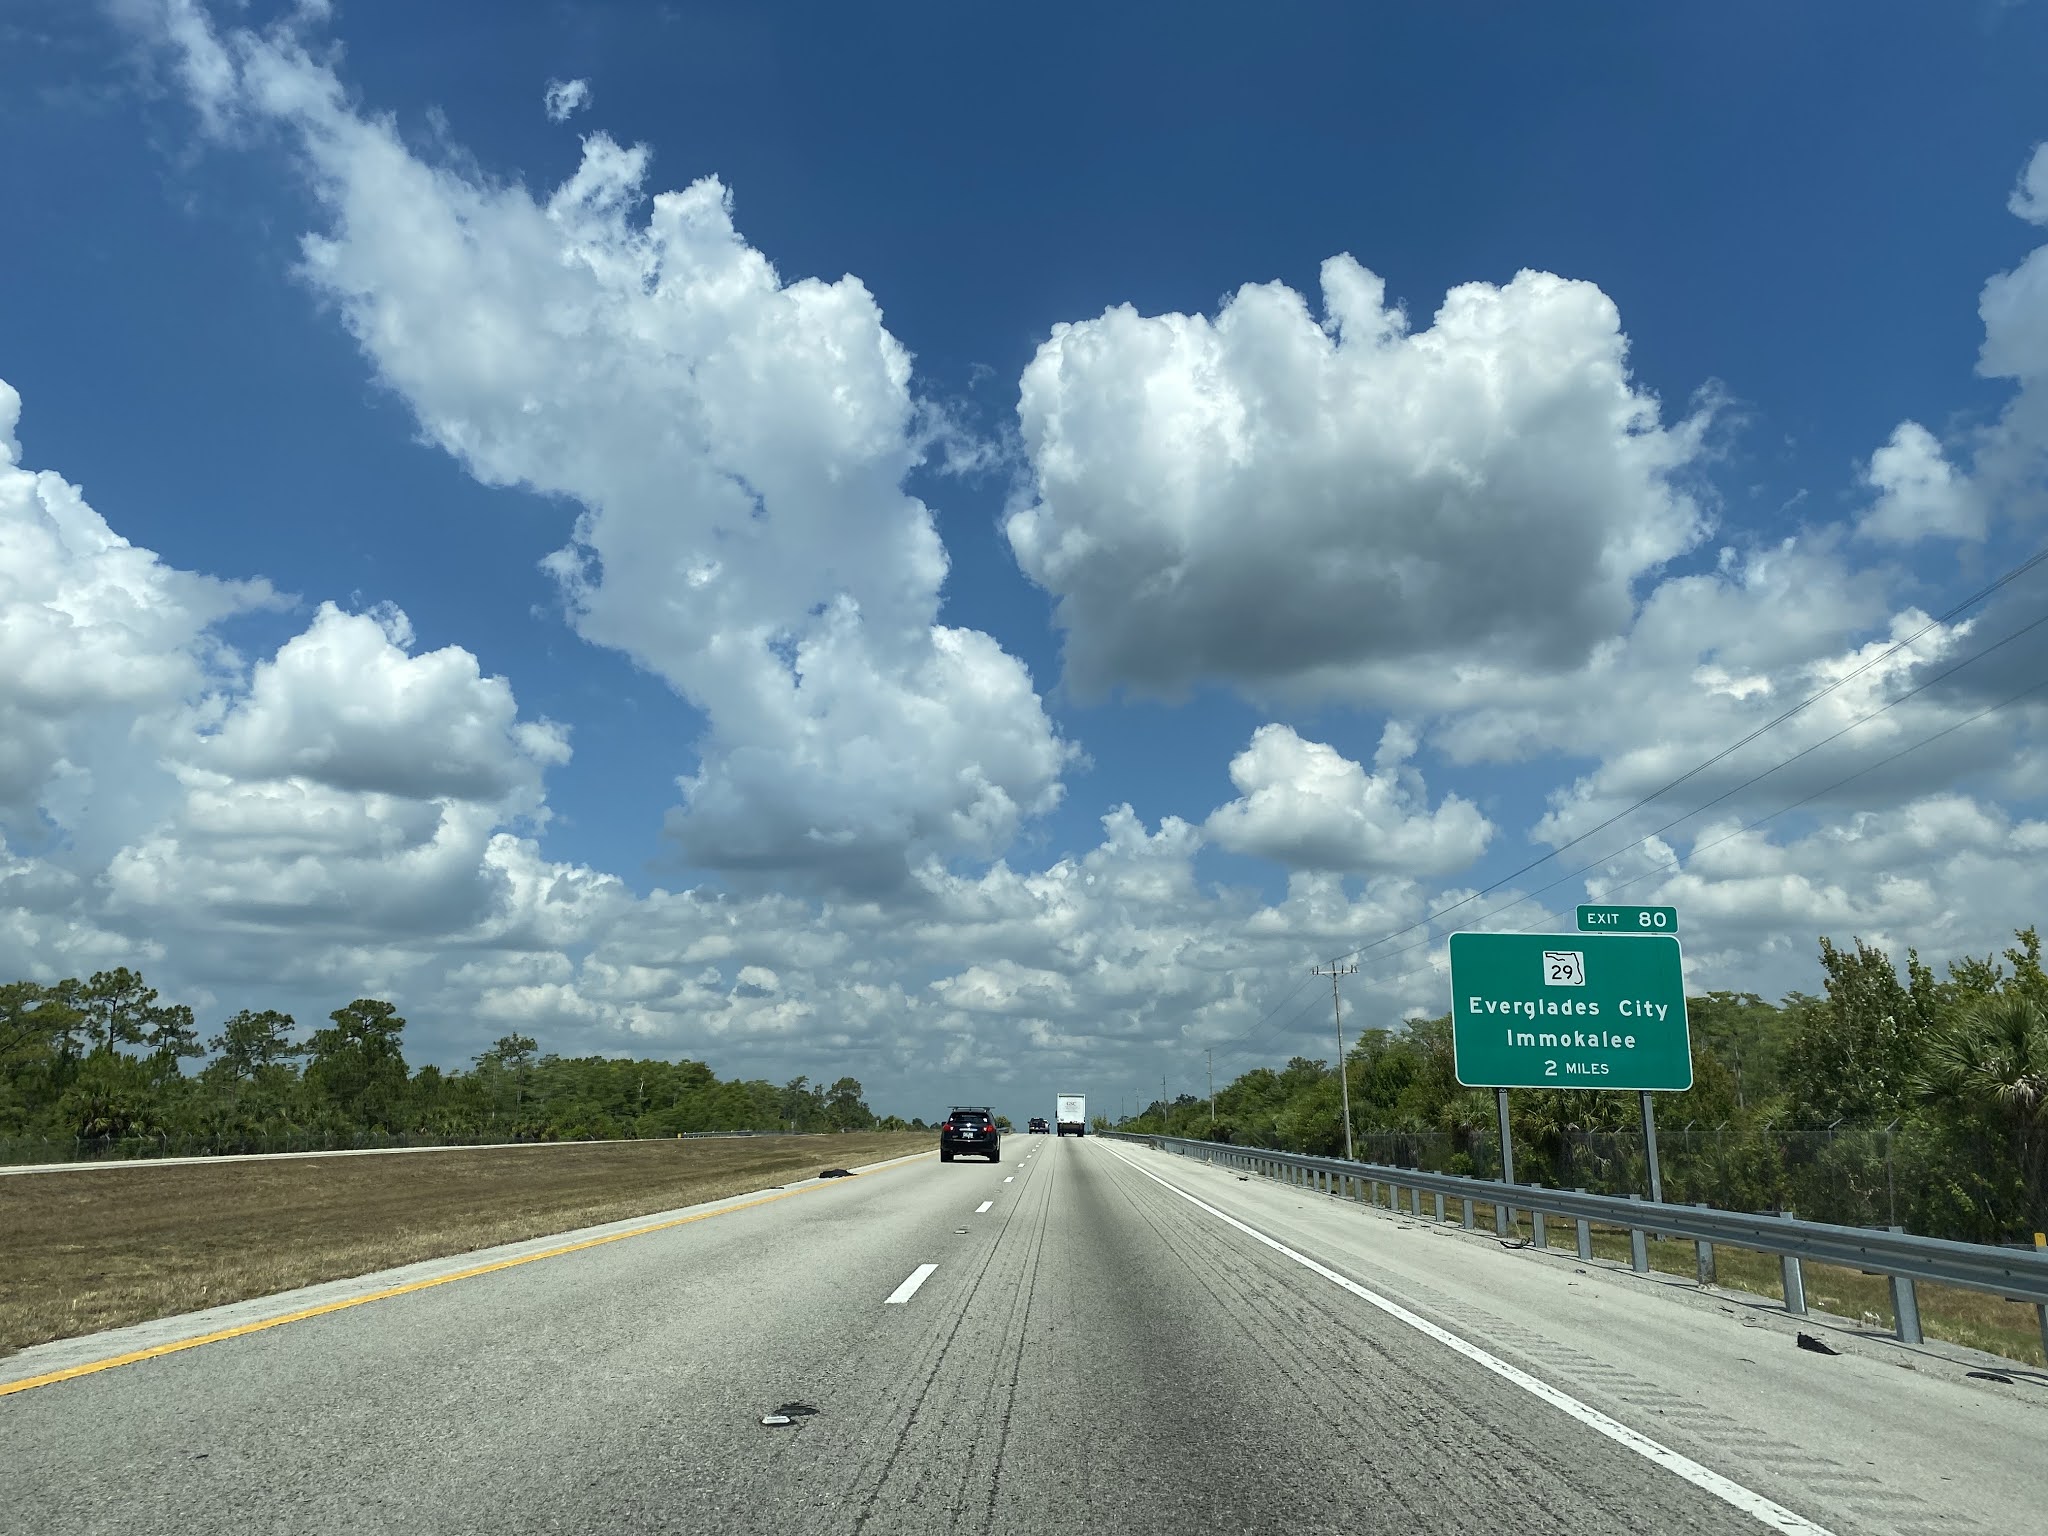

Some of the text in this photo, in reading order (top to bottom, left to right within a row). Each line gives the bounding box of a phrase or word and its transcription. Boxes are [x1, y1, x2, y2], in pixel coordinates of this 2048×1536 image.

[1587, 912, 1667, 928] EXIT 80
[1551, 965, 1573, 980] 29
[1469, 997, 1668, 1021] Everglades City
[1507, 1029, 1636, 1049] Immokalee
[1544, 1060, 1609, 1076] 2 MILES
